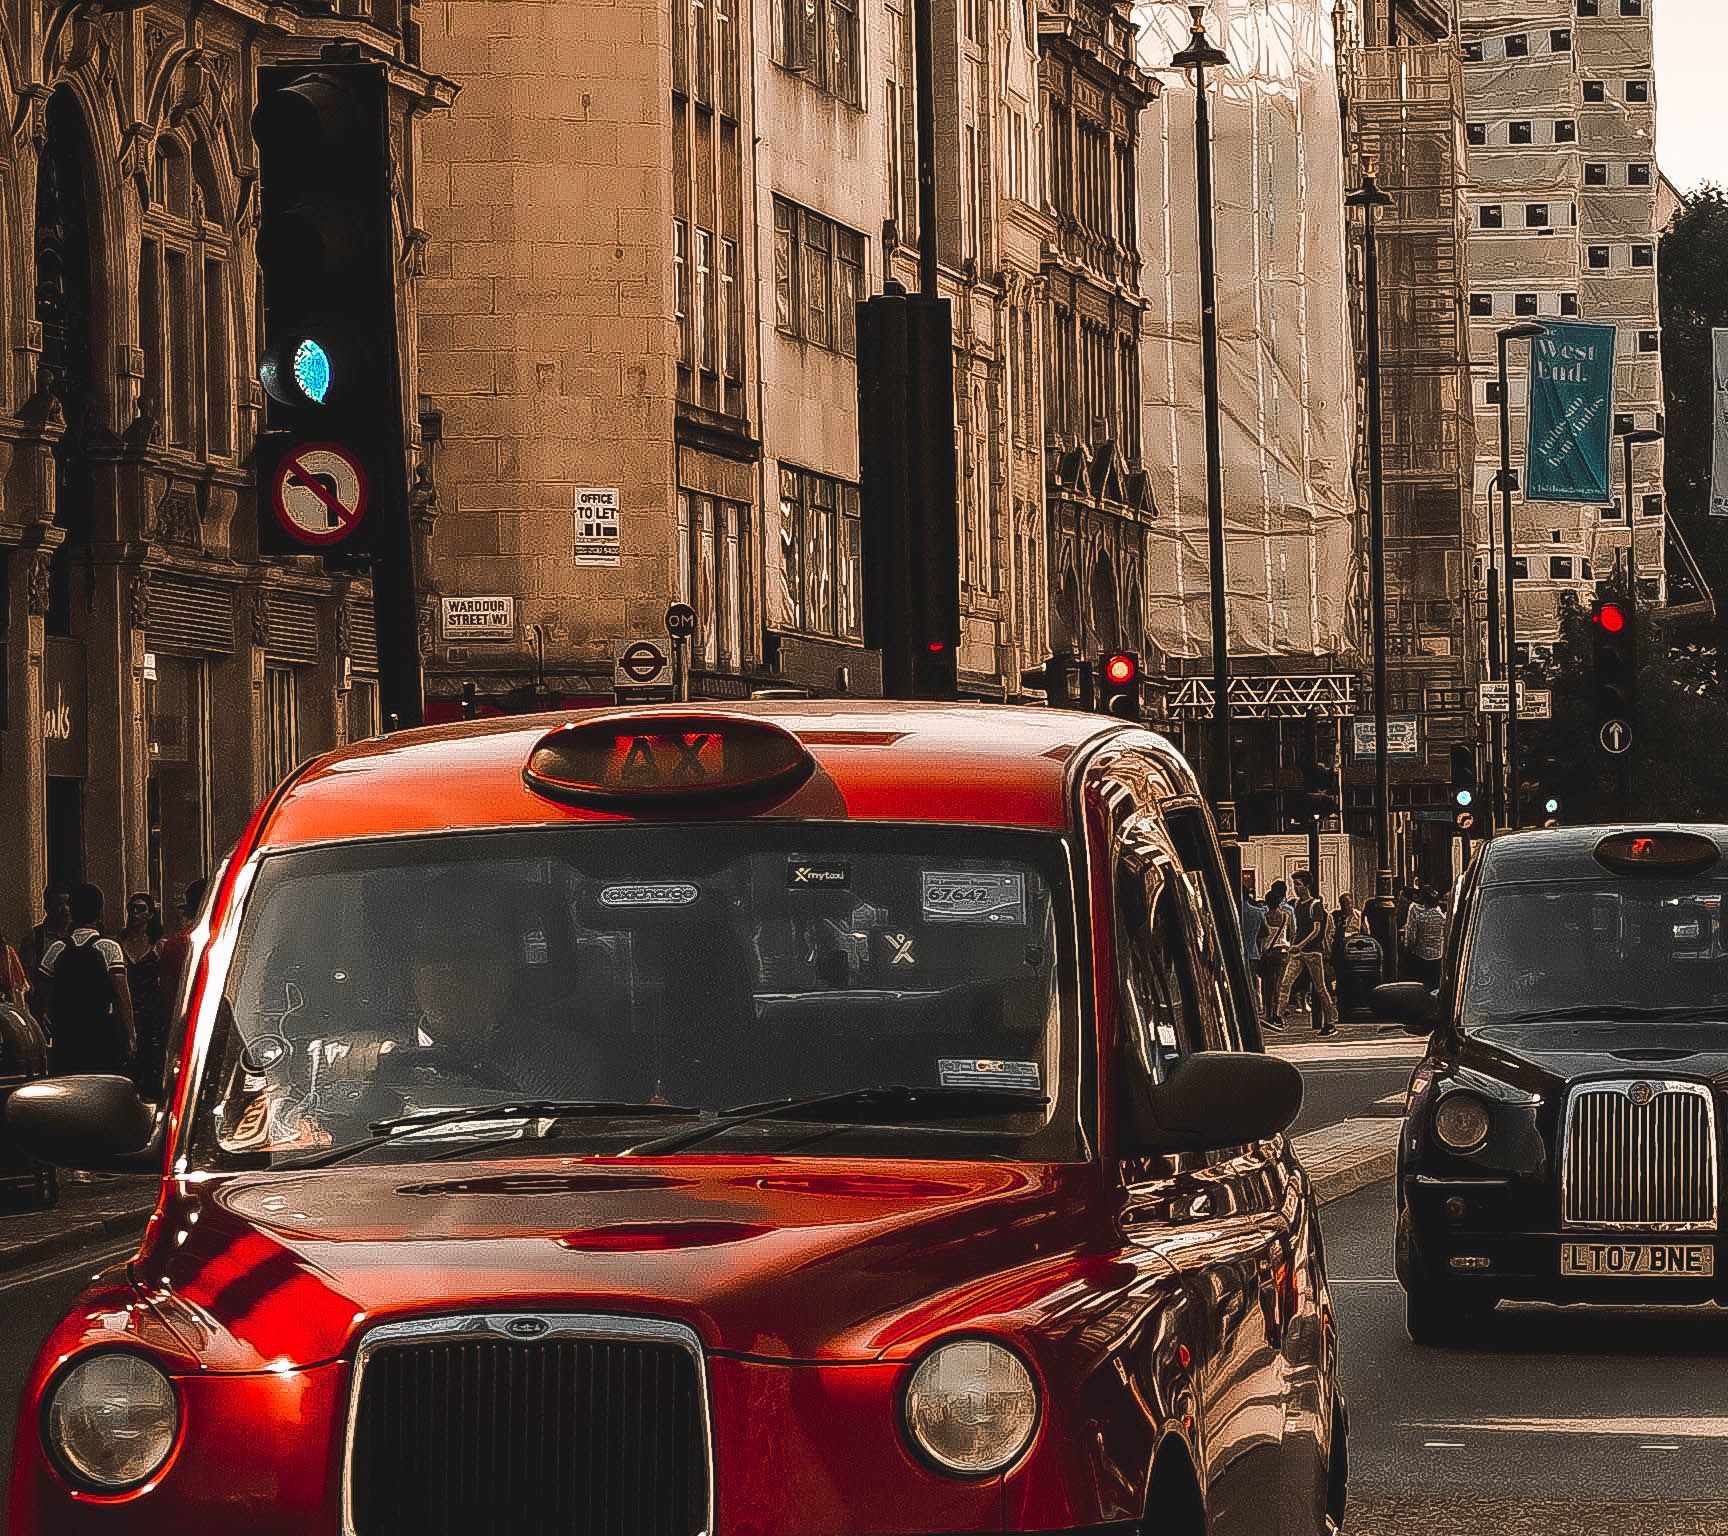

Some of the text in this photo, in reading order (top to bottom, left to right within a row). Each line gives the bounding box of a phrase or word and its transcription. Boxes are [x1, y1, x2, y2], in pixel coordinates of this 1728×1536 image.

[1538, 339, 1595, 361] West
[580, 493, 614, 504] OFFICE
[577, 507, 617, 519] TO LET
[448, 600, 505, 613] WARDOUR
[448, 614, 488, 625] STREET
[1571, 1246, 1704, 1272] LT07 BNE
